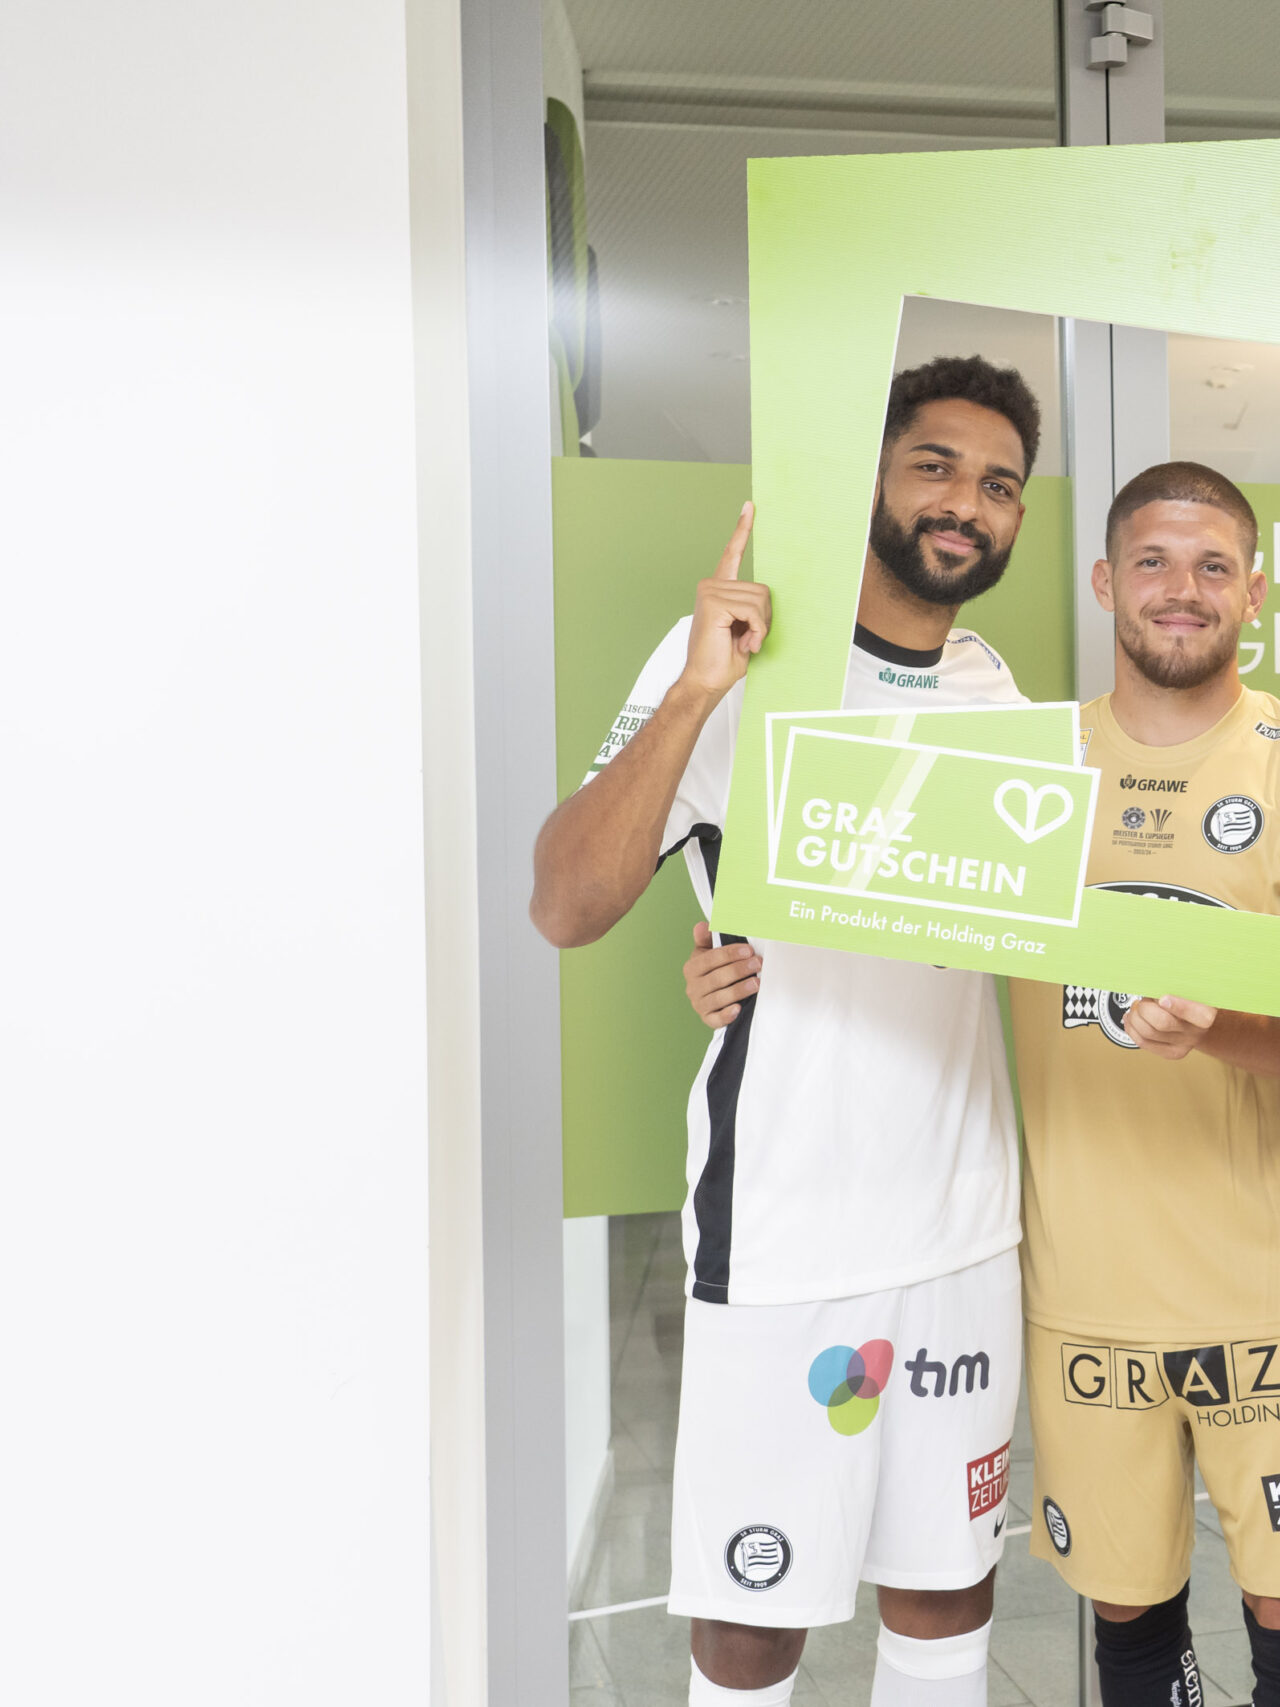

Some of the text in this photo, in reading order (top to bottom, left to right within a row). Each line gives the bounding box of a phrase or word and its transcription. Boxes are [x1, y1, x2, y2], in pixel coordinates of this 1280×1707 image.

[897, 673, 939, 689] GRAWE
[1137, 778, 1189, 793] GRAWE
[802, 798, 917, 842] GRAZ
[796, 835, 1027, 897] GUTSCHEIN
[789, 900, 1047, 955] Ein Produkt der Holding Graz
